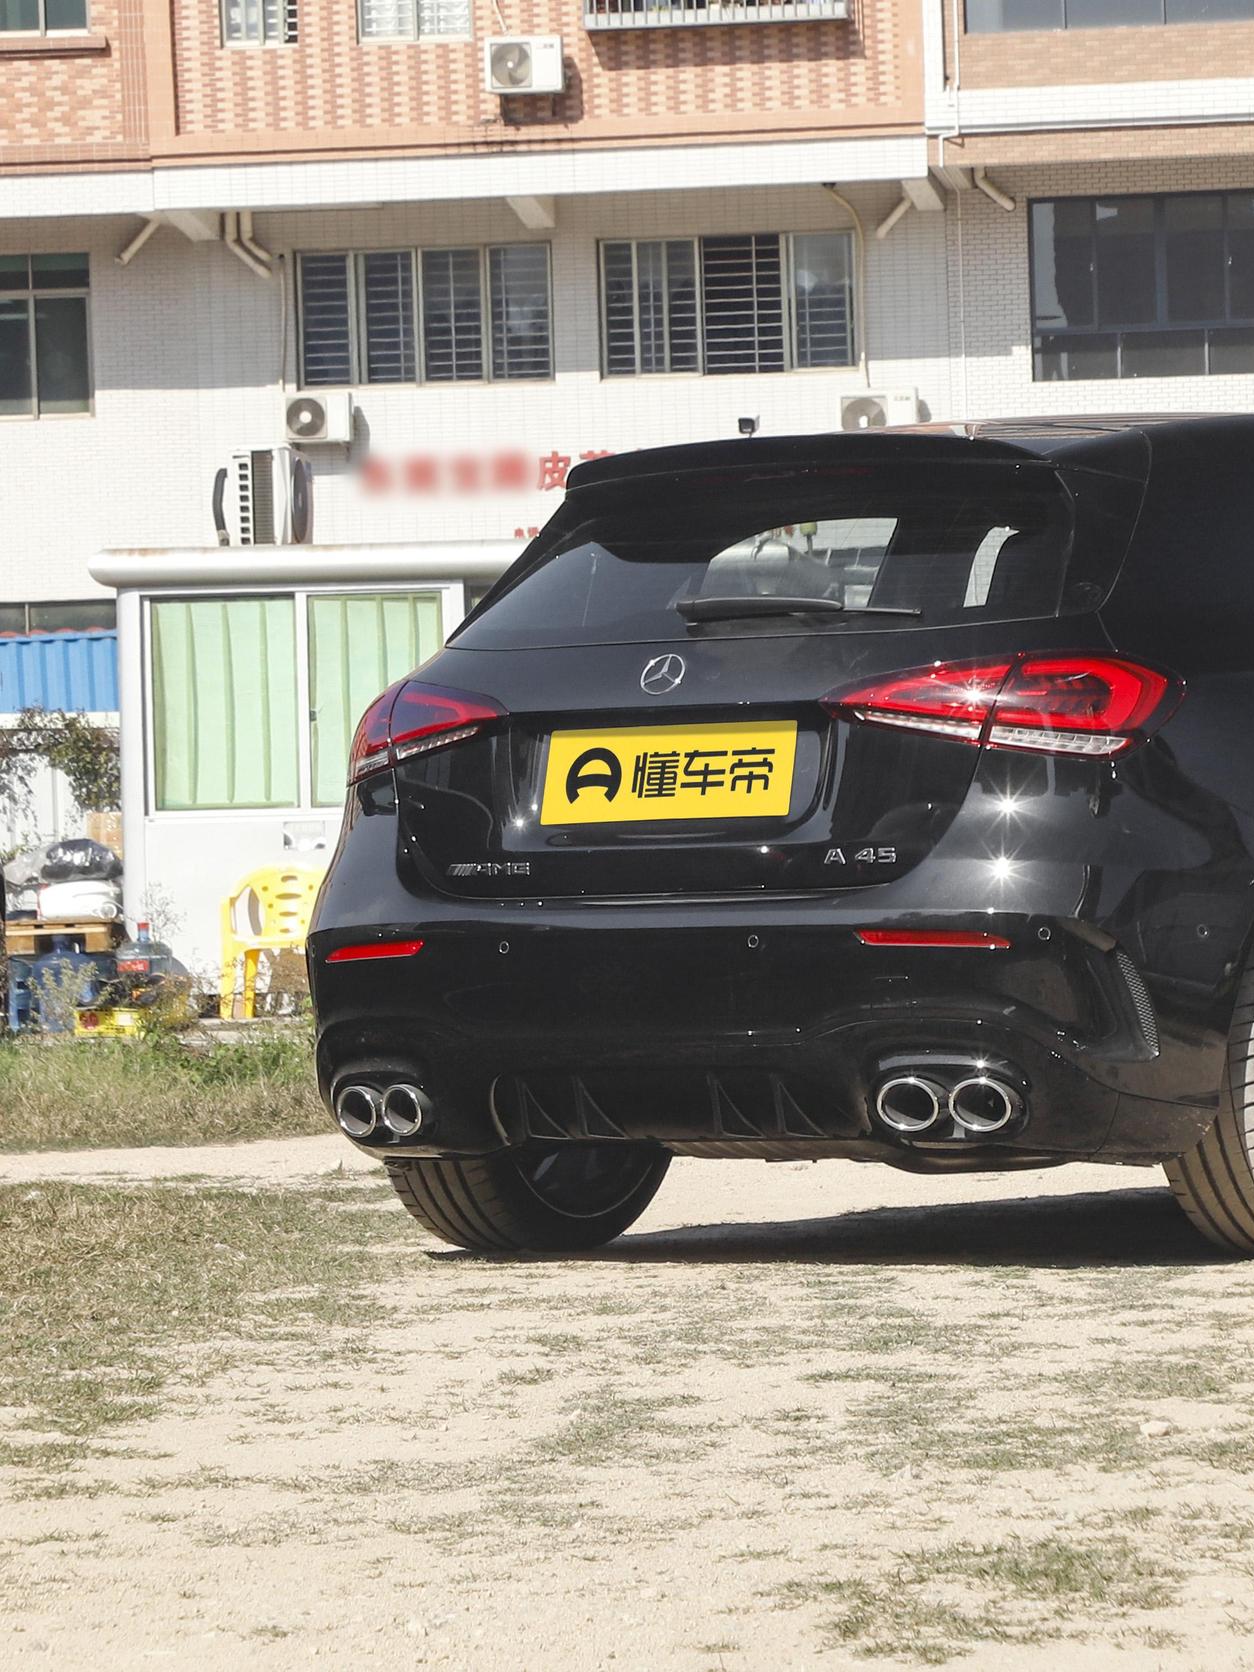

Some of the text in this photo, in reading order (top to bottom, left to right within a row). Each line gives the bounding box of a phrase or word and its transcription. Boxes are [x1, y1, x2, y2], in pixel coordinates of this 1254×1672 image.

[632, 747, 776, 799] 懂车帝
[823, 848, 896, 865] A 45
